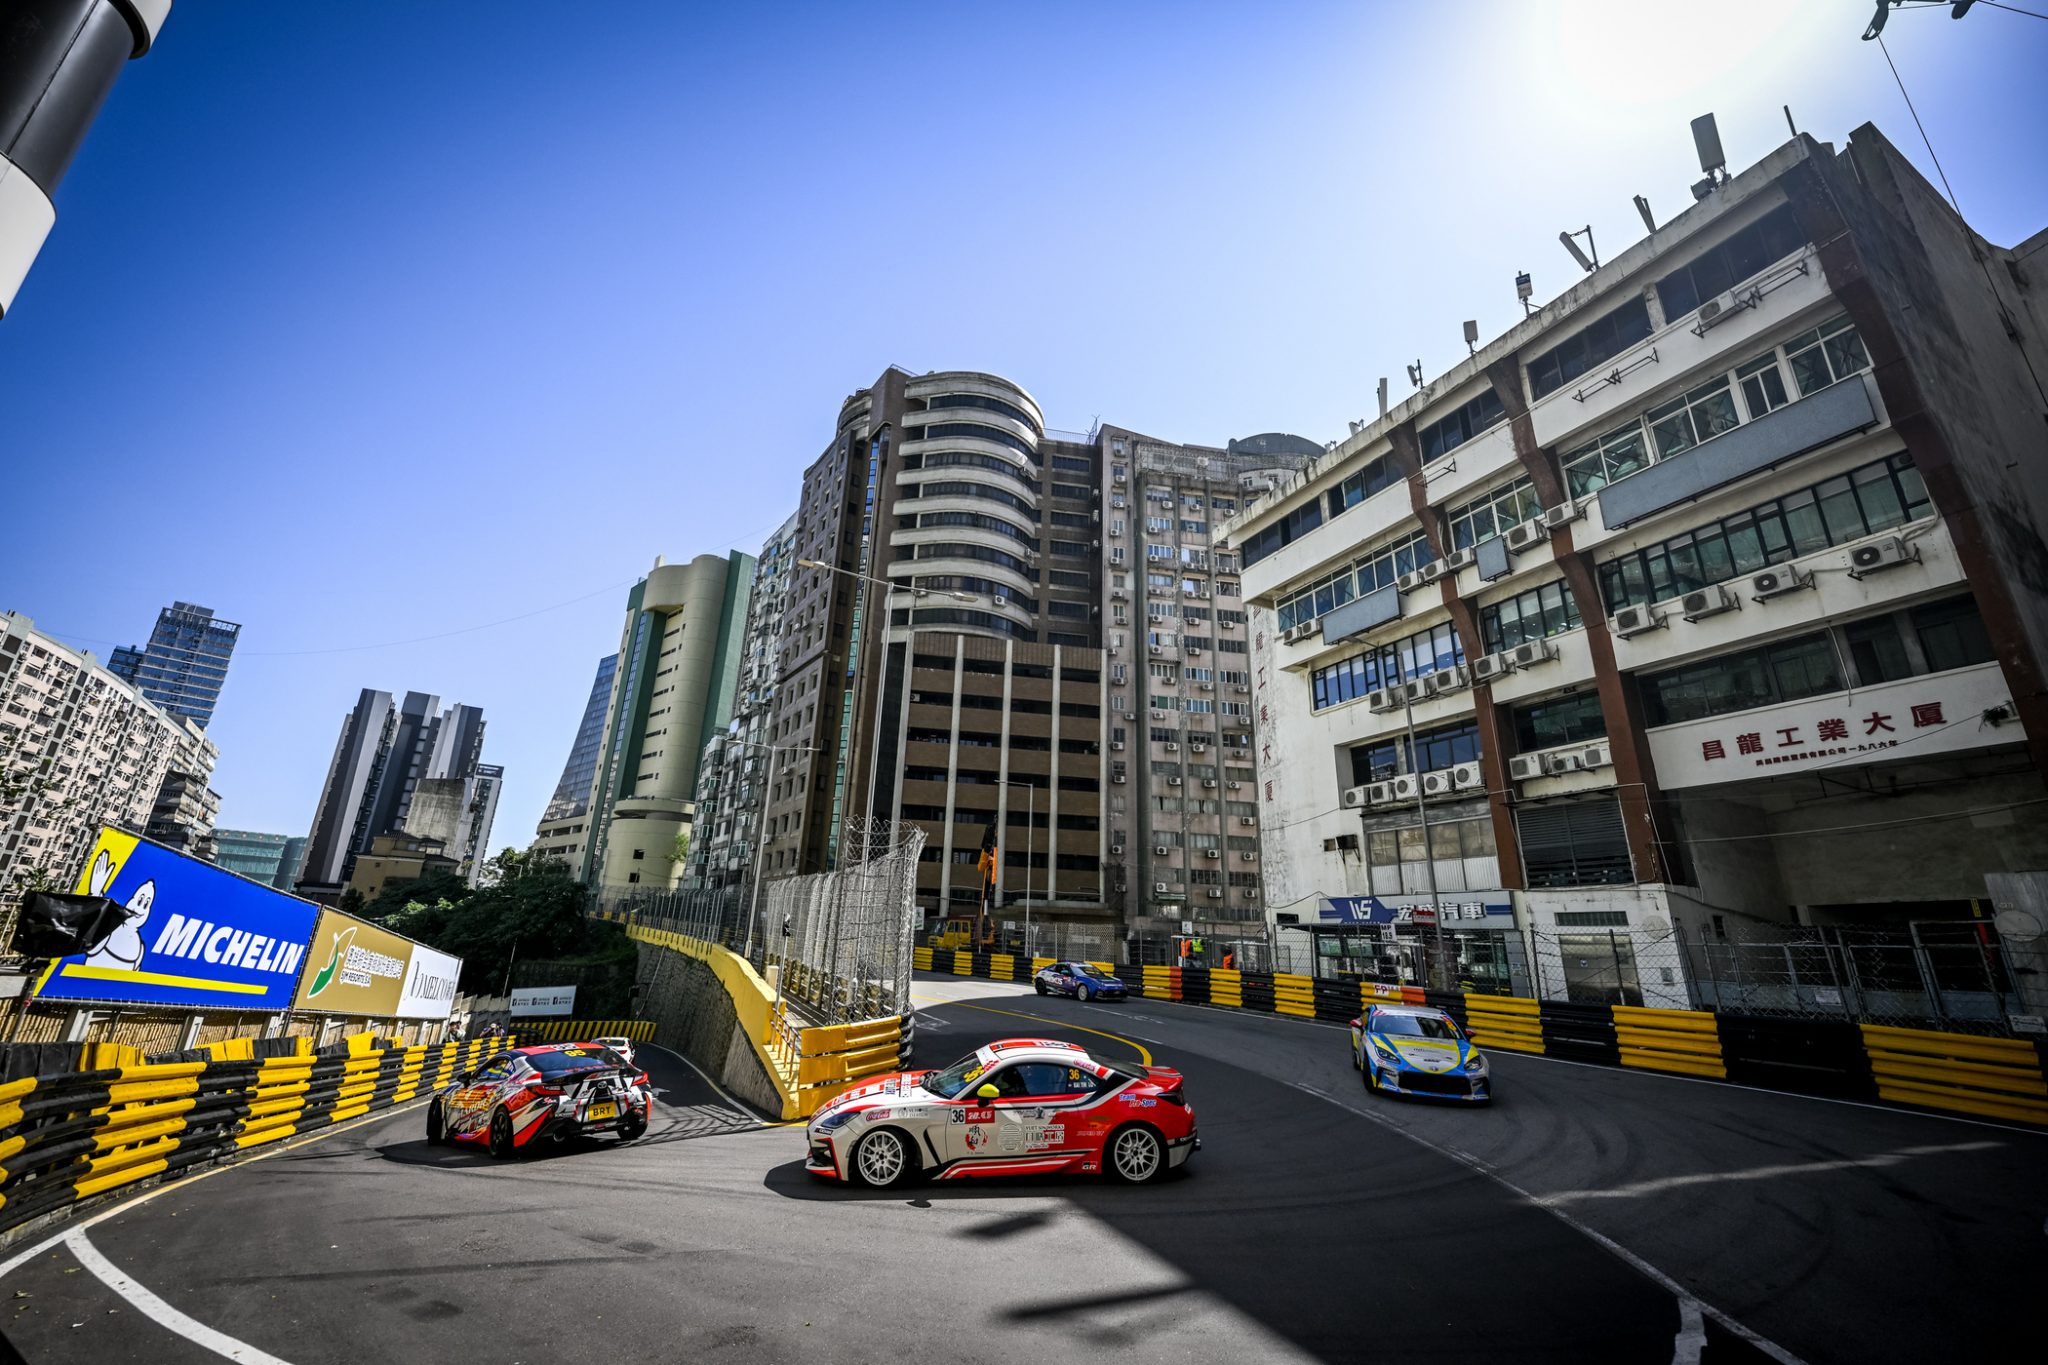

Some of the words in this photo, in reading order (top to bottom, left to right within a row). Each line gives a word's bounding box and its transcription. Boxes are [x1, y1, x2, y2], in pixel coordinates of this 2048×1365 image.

[1701, 701, 1948, 761] 昌龍工業大廈
[151, 913, 305, 975] MICHELIN
[1068, 1068, 1080, 1080] 36
[593, 1106, 612, 1117] BRY
[952, 1109, 964, 1123] 36
